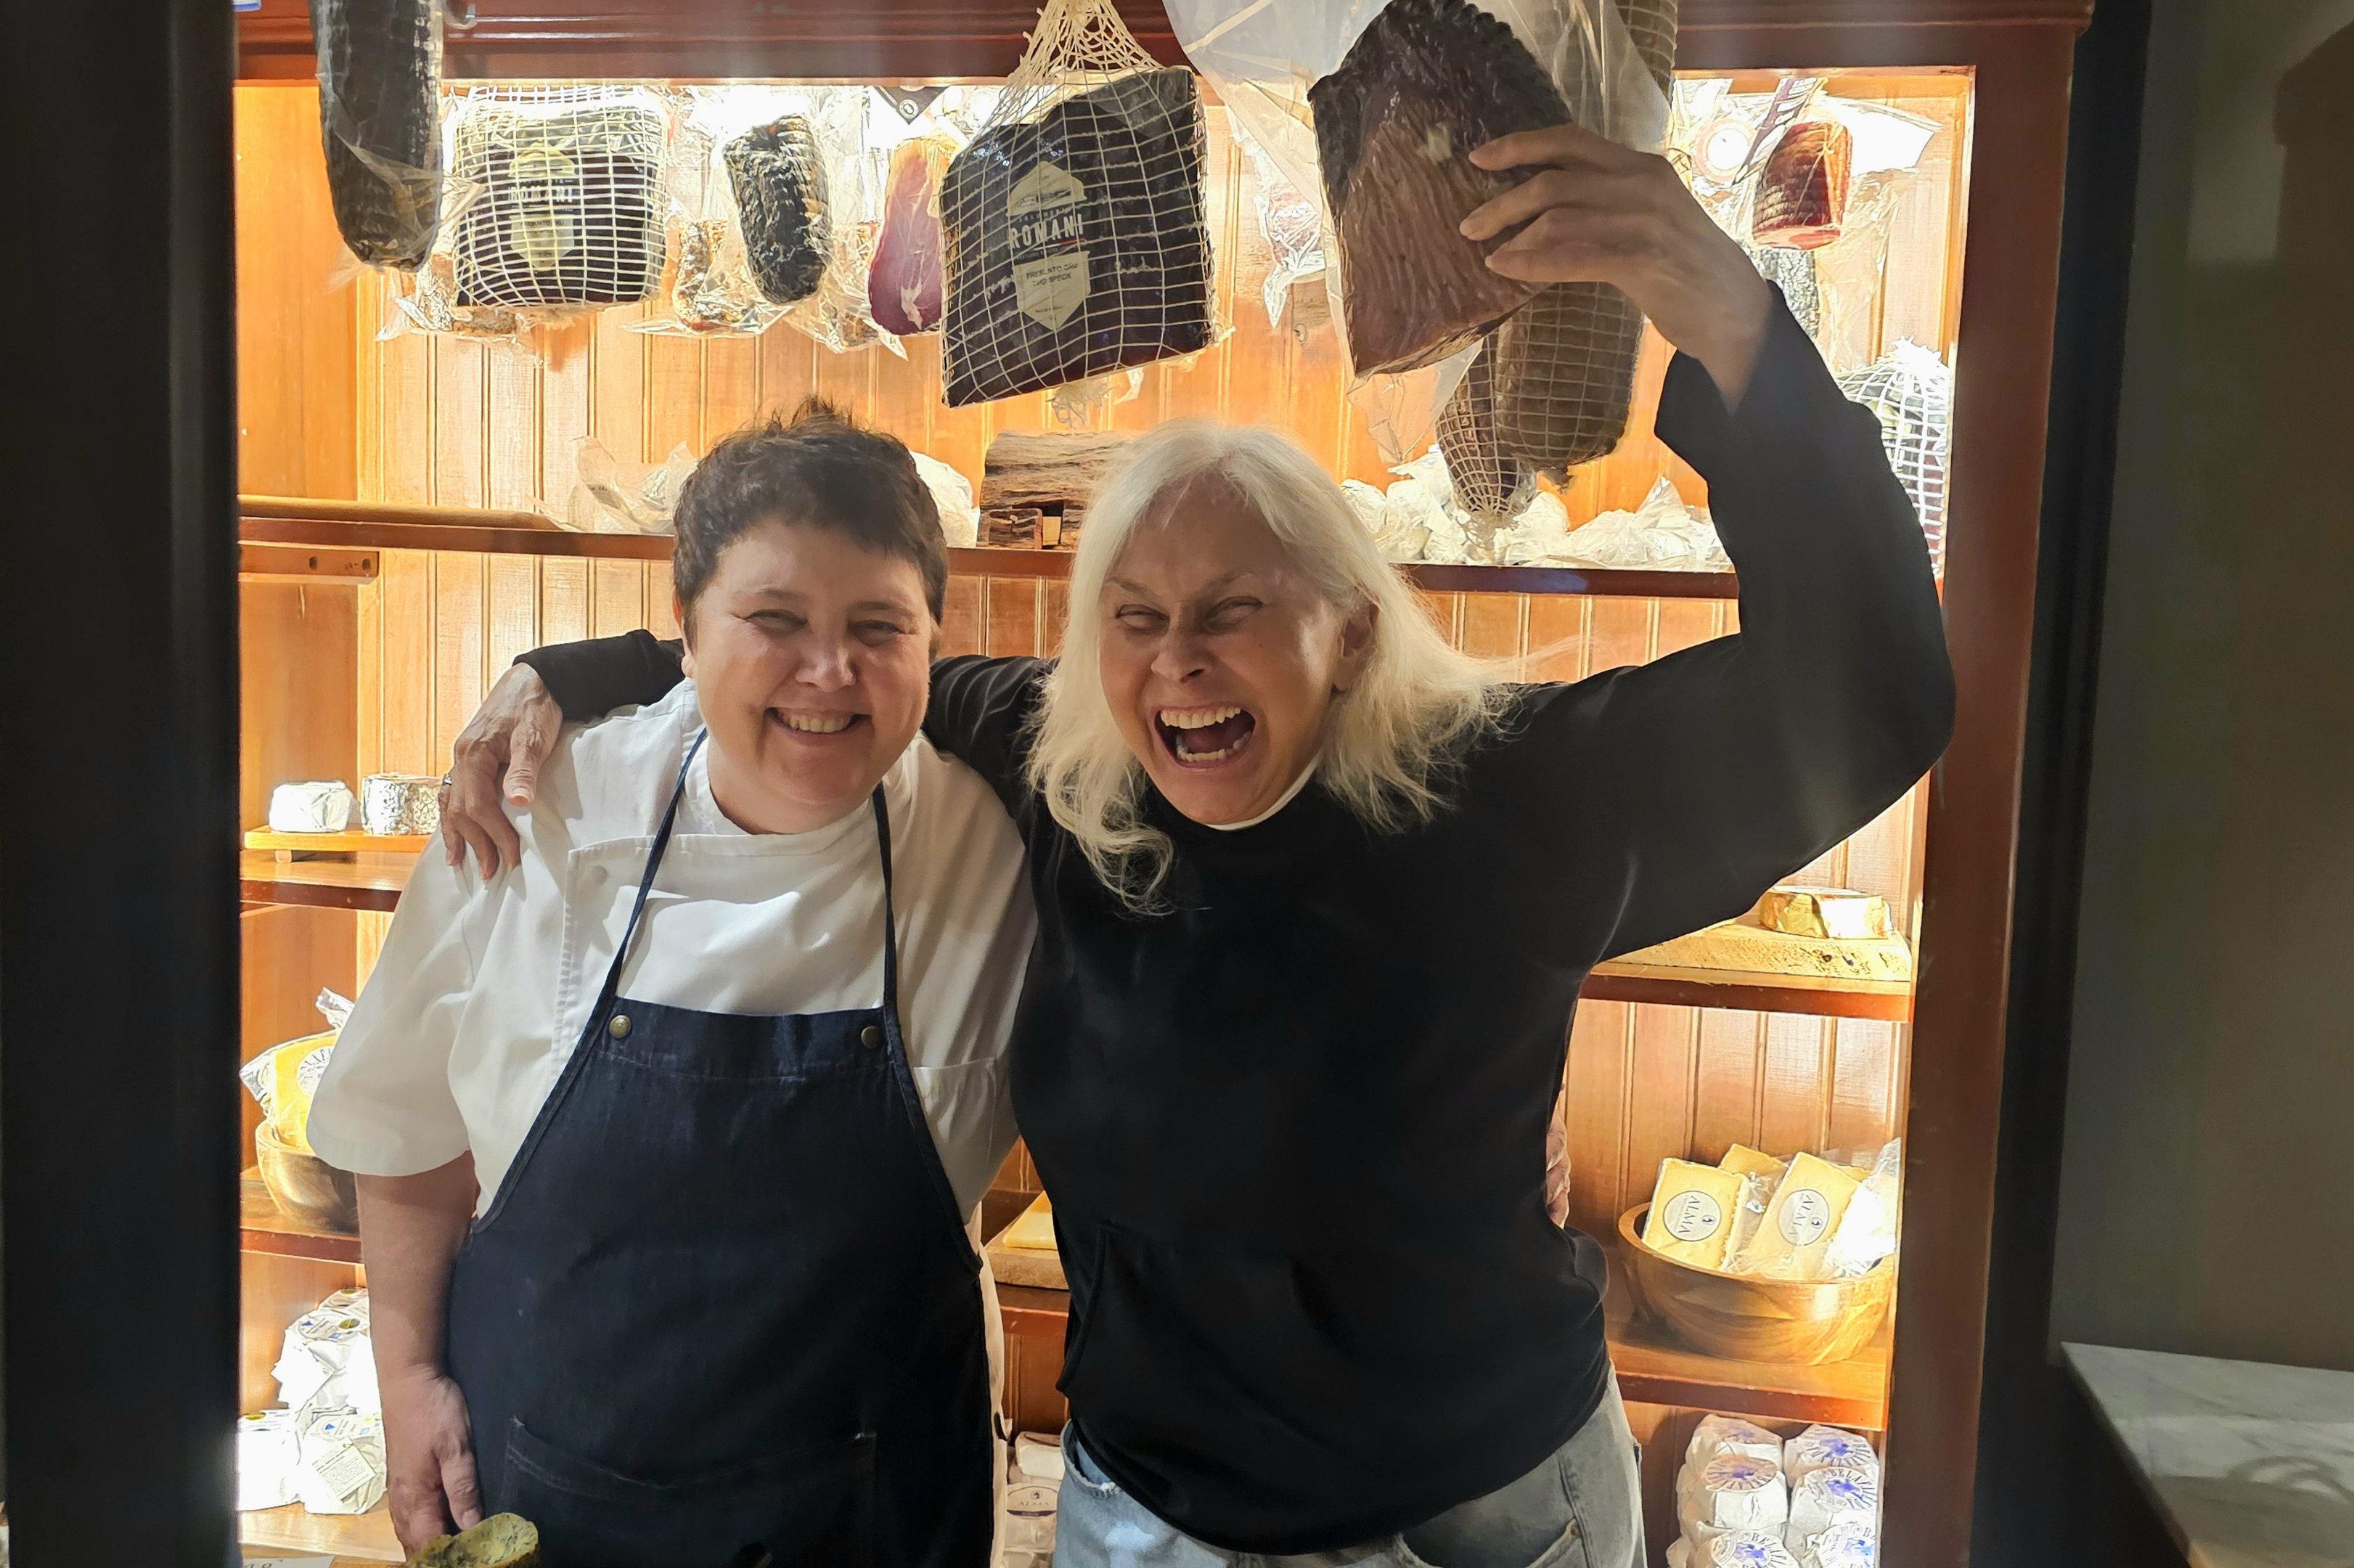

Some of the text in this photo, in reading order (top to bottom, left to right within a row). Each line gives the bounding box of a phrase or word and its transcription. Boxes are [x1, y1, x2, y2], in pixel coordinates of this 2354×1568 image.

[1008, 213, 1084, 249] ROMANI
[1049, 273, 1072, 283] SPECK
[1678, 1196, 1701, 1233] ALMA
